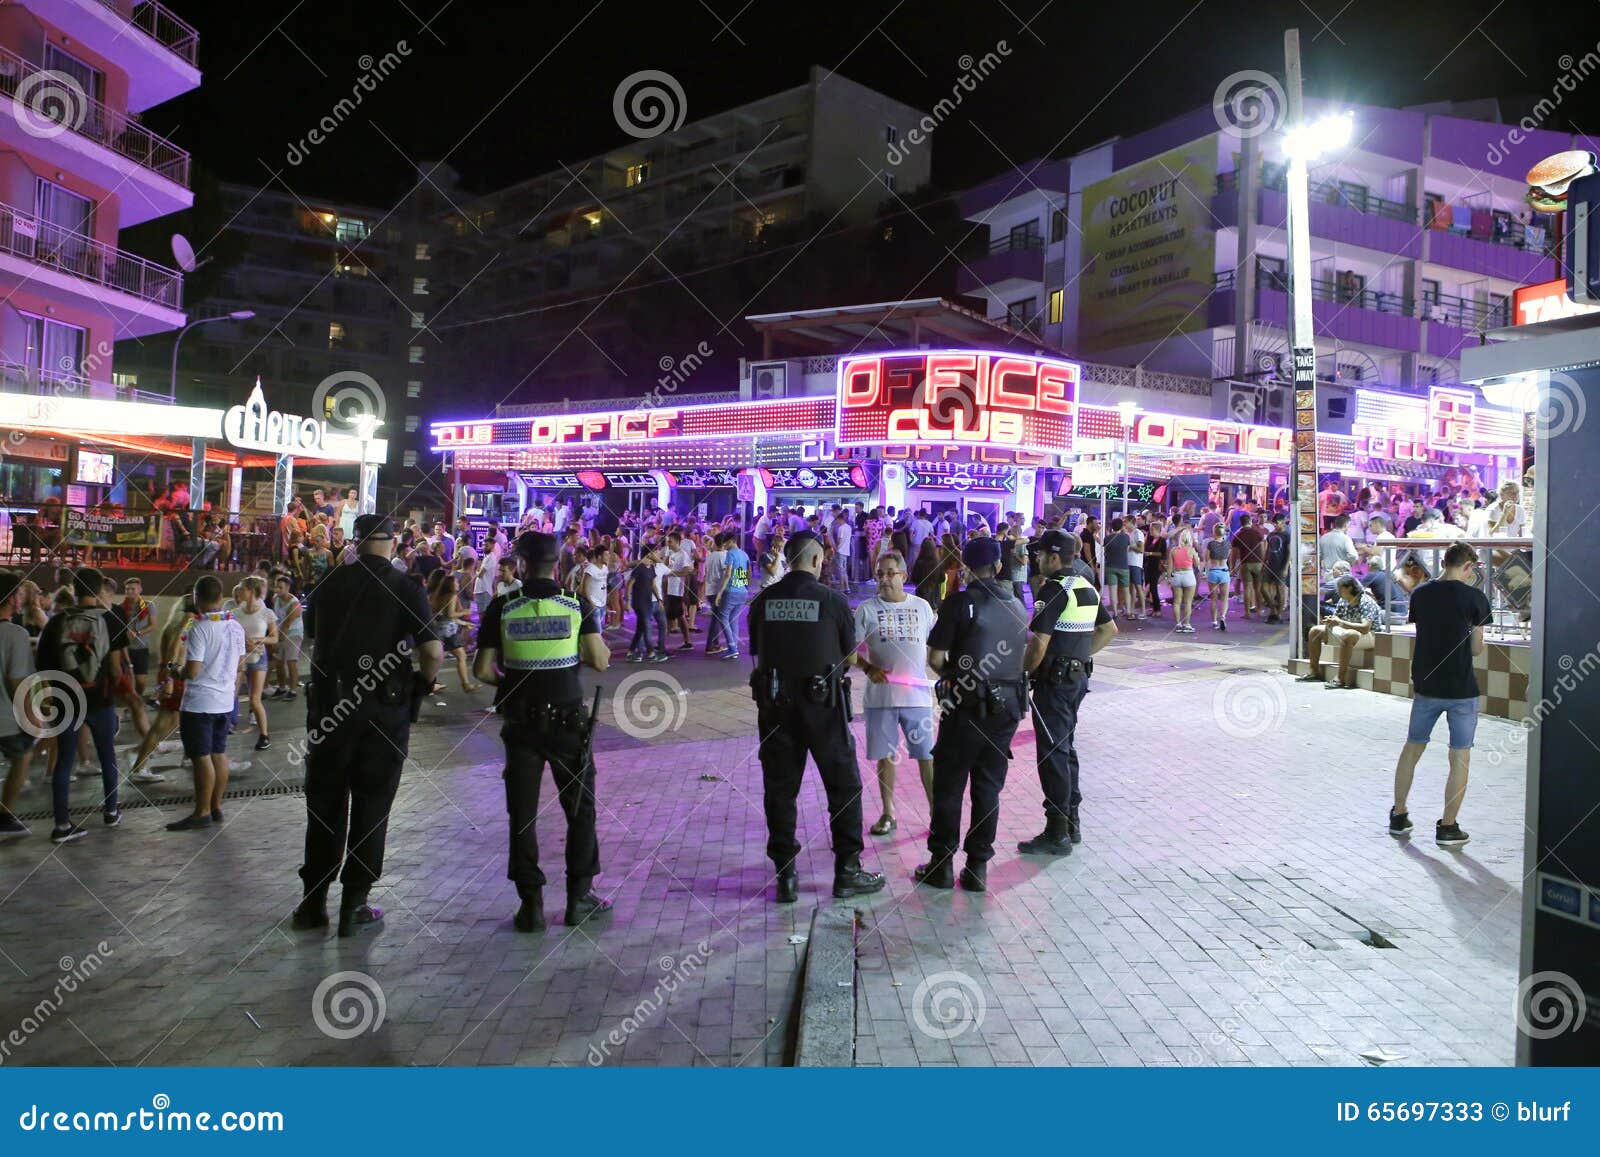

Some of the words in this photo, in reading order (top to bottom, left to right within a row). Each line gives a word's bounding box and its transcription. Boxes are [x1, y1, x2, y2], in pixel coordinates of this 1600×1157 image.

[1110, 178, 1178, 219] COCONUT
[1110, 204, 1178, 239] APARTMENTS
[1296, 355, 1313, 367] TAKE
[1296, 370, 1313, 382] AWAY
[842, 355, 1075, 415] OFFICE
[437, 425, 493, 446] CLUB
[531, 408, 679, 444] OFFICE
[888, 409, 1024, 443] CLUB
[606, 475, 656, 485] CLUB
[68, 511, 81, 520] GO
[67, 520, 86, 530] FOR
[772, 610, 809, 619] LOCAL
